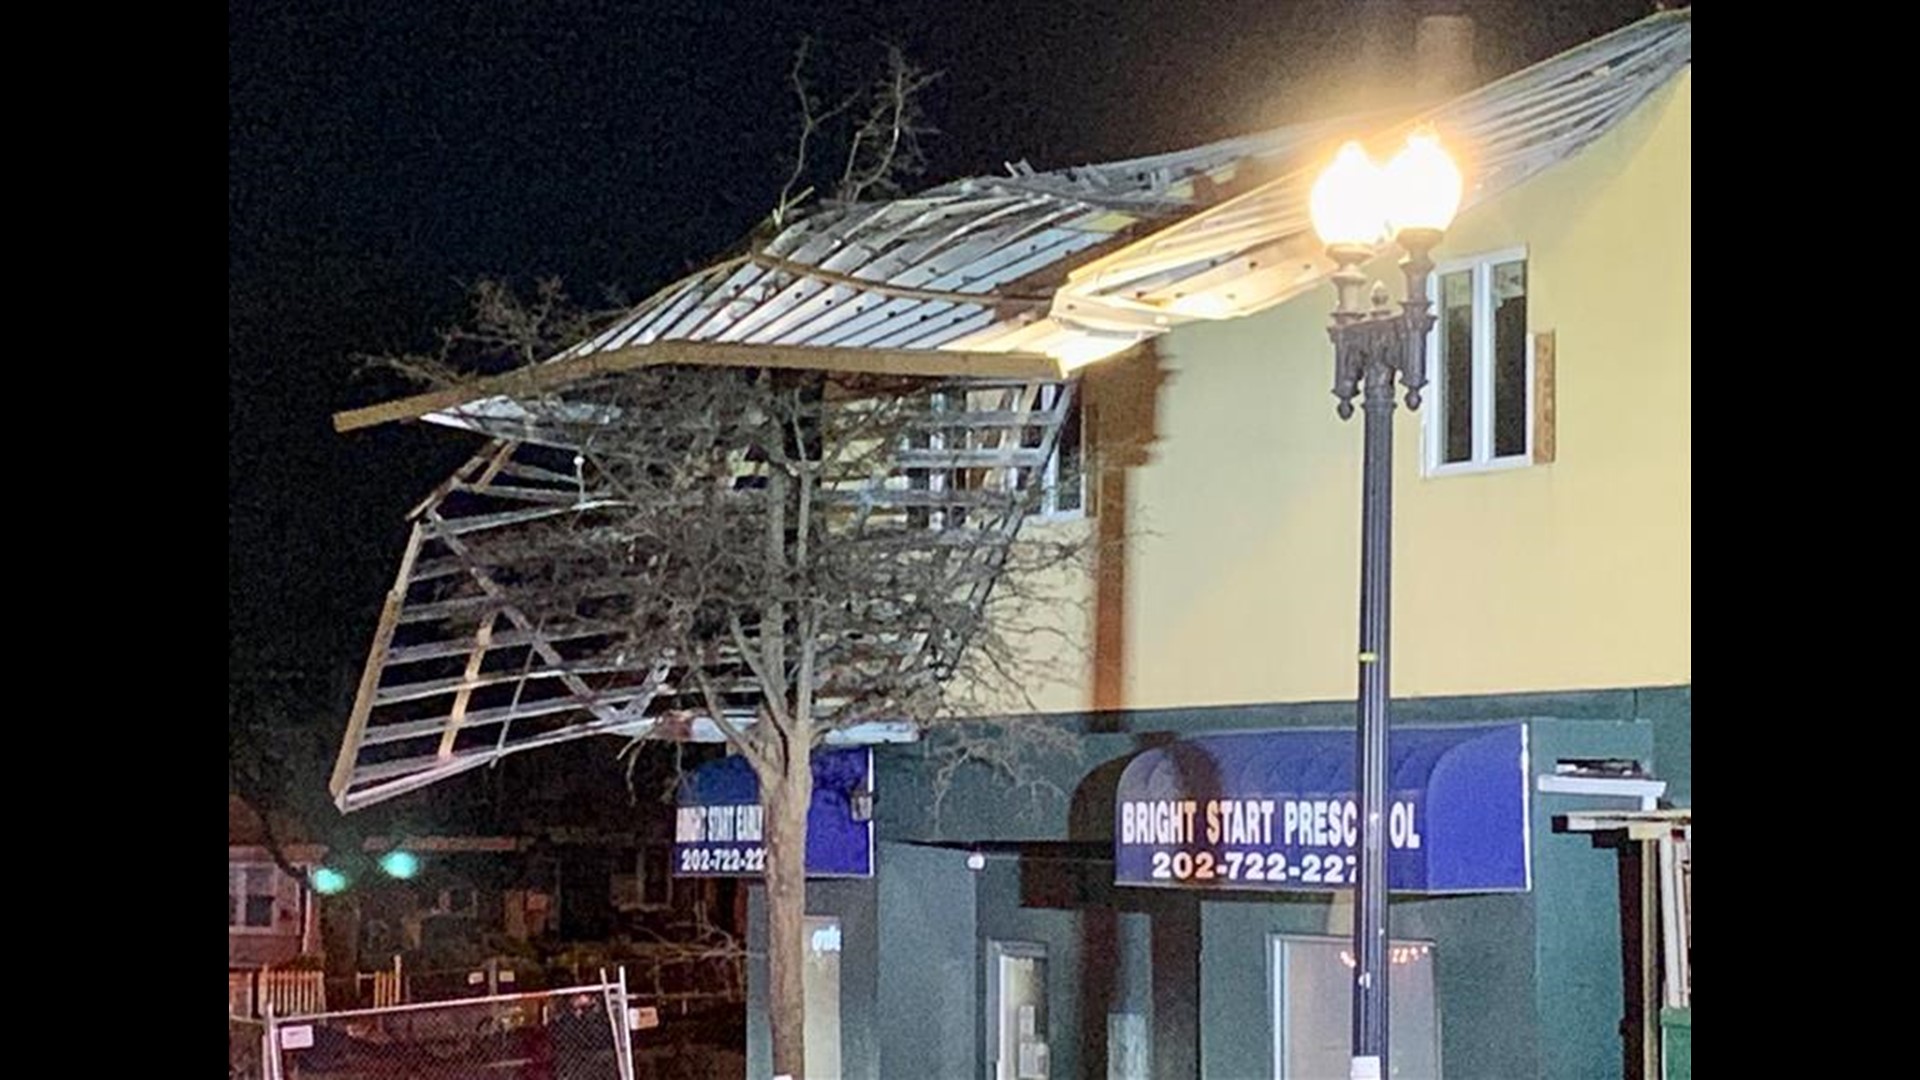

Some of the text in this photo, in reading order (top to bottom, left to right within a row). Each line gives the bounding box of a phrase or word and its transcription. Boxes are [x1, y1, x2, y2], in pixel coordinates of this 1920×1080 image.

[1122, 799, 1421, 849] BRIGHT START PRESCOL
